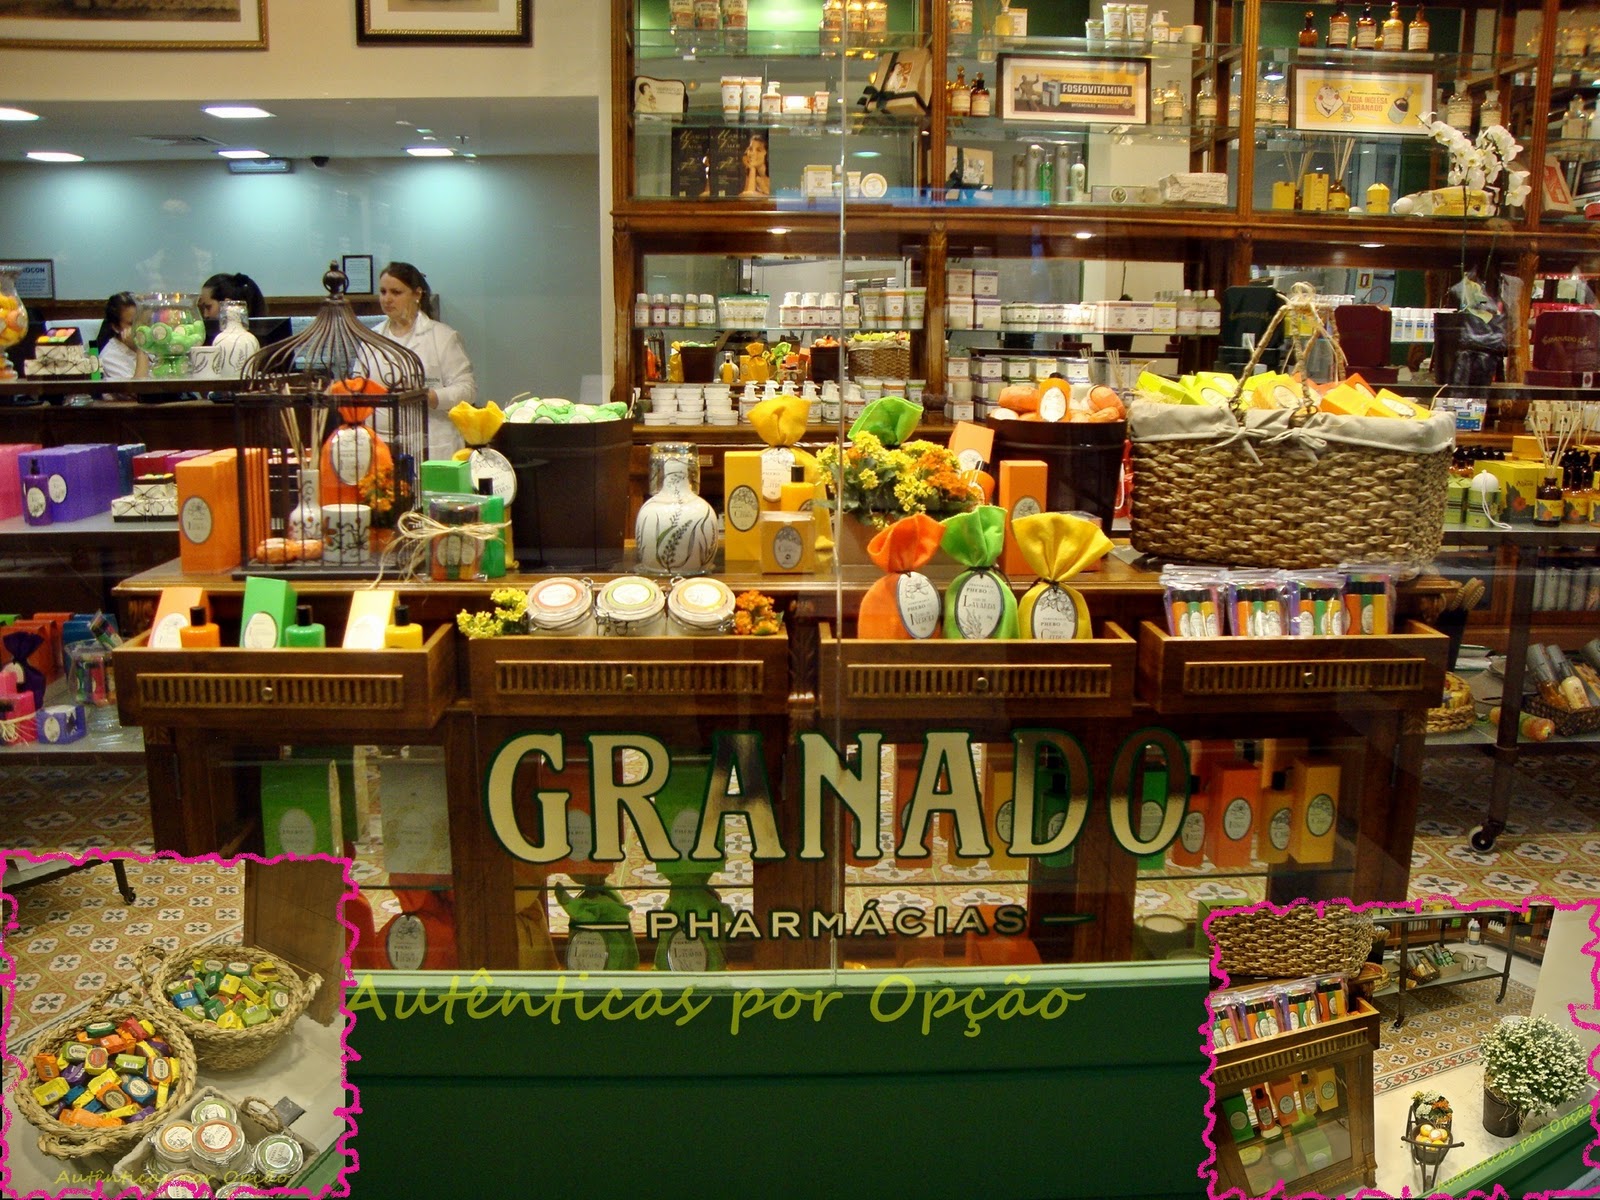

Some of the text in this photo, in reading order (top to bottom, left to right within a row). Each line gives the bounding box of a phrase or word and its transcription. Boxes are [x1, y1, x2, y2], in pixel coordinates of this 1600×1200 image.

[1062, 83, 1129, 95] FOSFOVITAMINA
[485, 728, 1191, 865] GRANADO
[648, 903, 1027, 940] PHARMÁCIAS
